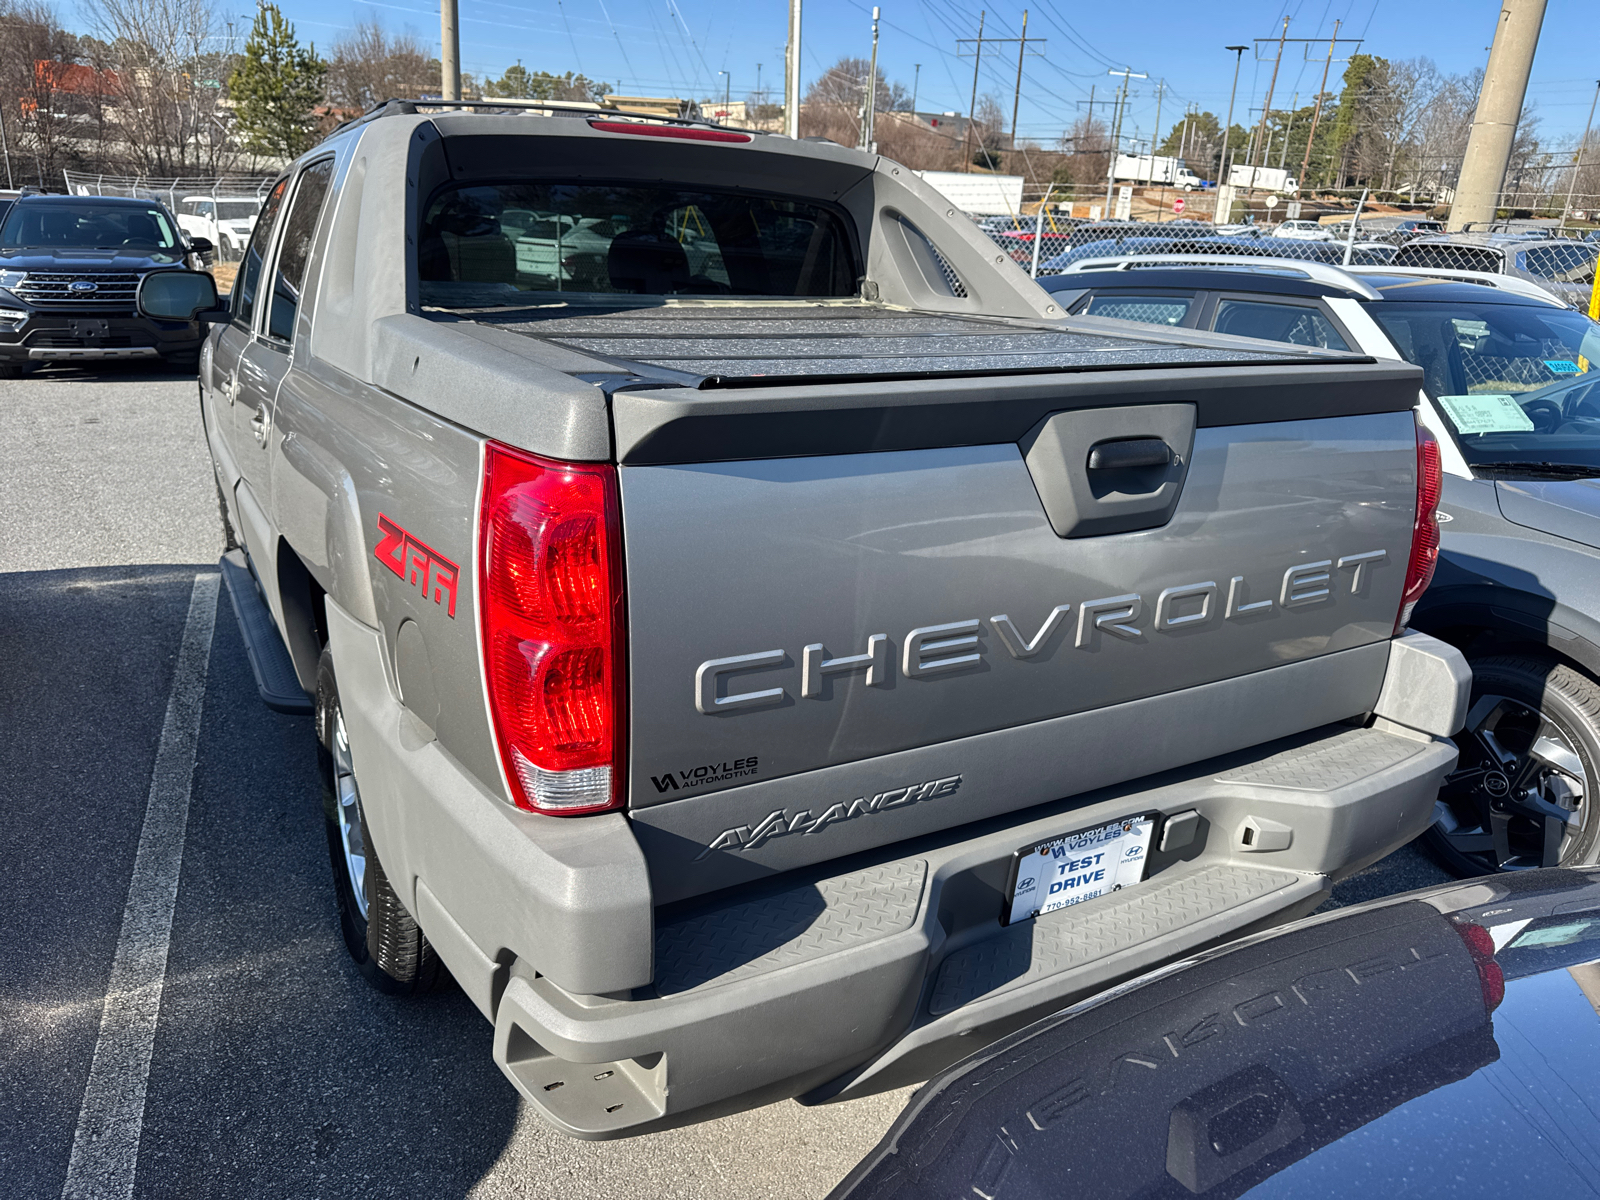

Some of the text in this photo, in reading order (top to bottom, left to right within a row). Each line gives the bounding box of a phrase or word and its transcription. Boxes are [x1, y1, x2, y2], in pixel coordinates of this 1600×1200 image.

[695, 549, 1387, 715] CHEVROLET
[679, 756, 759, 780] VOYLES
[681, 767, 758, 790] AUTOMOTIVE
[694, 773, 963, 864] AVALANCHE
[1069, 829, 1122, 850] VOYLES
[1058, 852, 1106, 875] TEST
[1120, 855, 1144, 865] HYUNDAI
[1049, 868, 1106, 895] DRIVE
[1046, 888, 1102, 911] 770-952-8881
